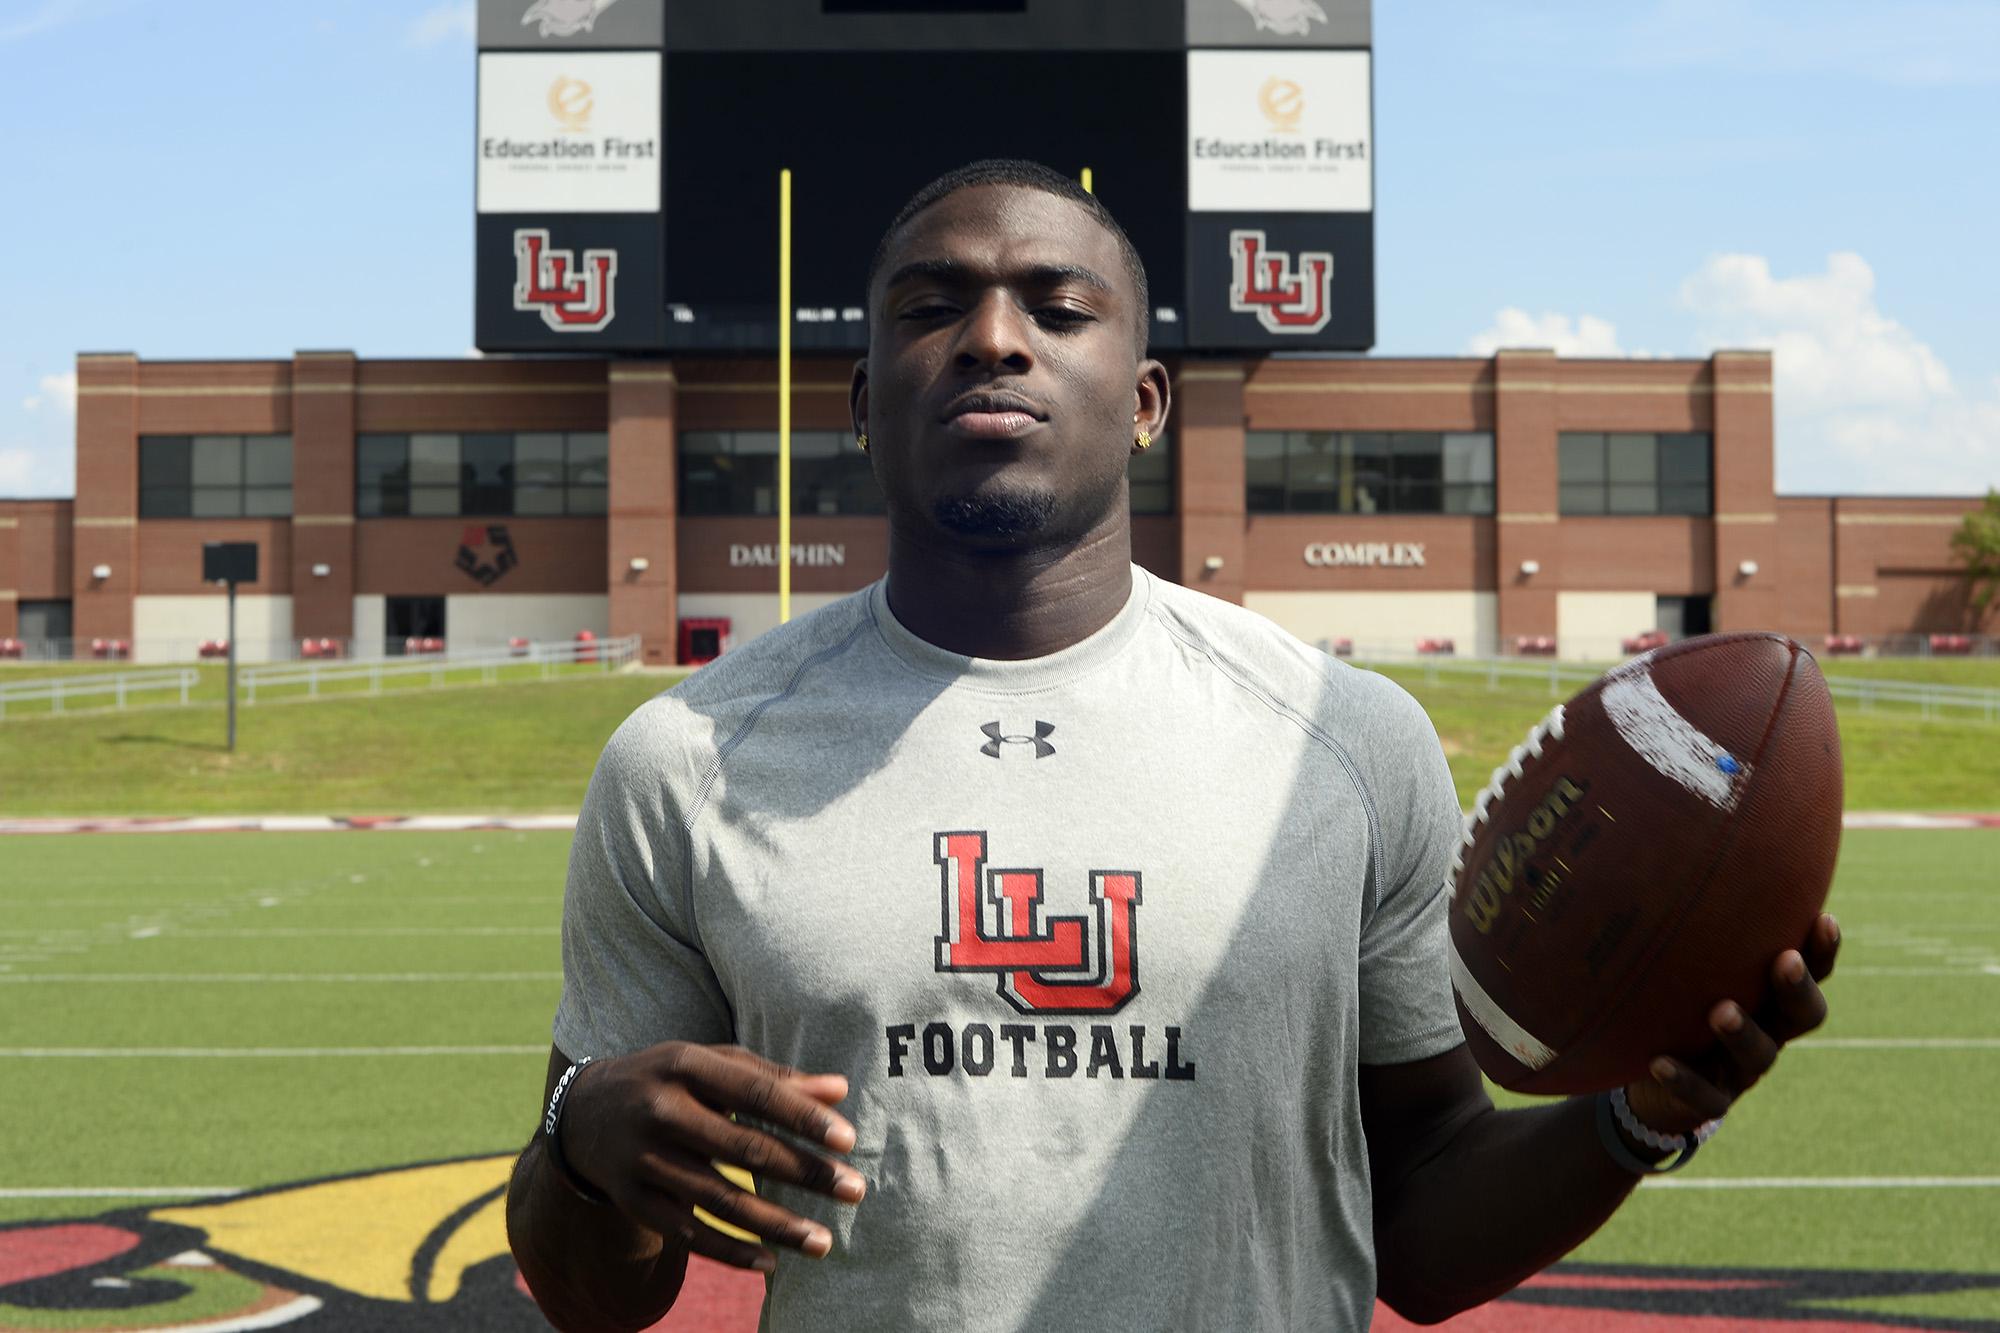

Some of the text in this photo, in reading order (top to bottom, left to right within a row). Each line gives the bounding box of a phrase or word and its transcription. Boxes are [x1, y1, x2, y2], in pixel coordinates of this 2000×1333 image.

[483, 138, 655, 159] Education First
[1194, 138, 1366, 159] Education First
[513, 228, 617, 333] LU
[1230, 229, 1334, 334] LU
[1303, 543, 1426, 567] COMPLEX
[933, 831, 1143, 1015] LU
[886, 1022, 1196, 1080] FOOTBALL
